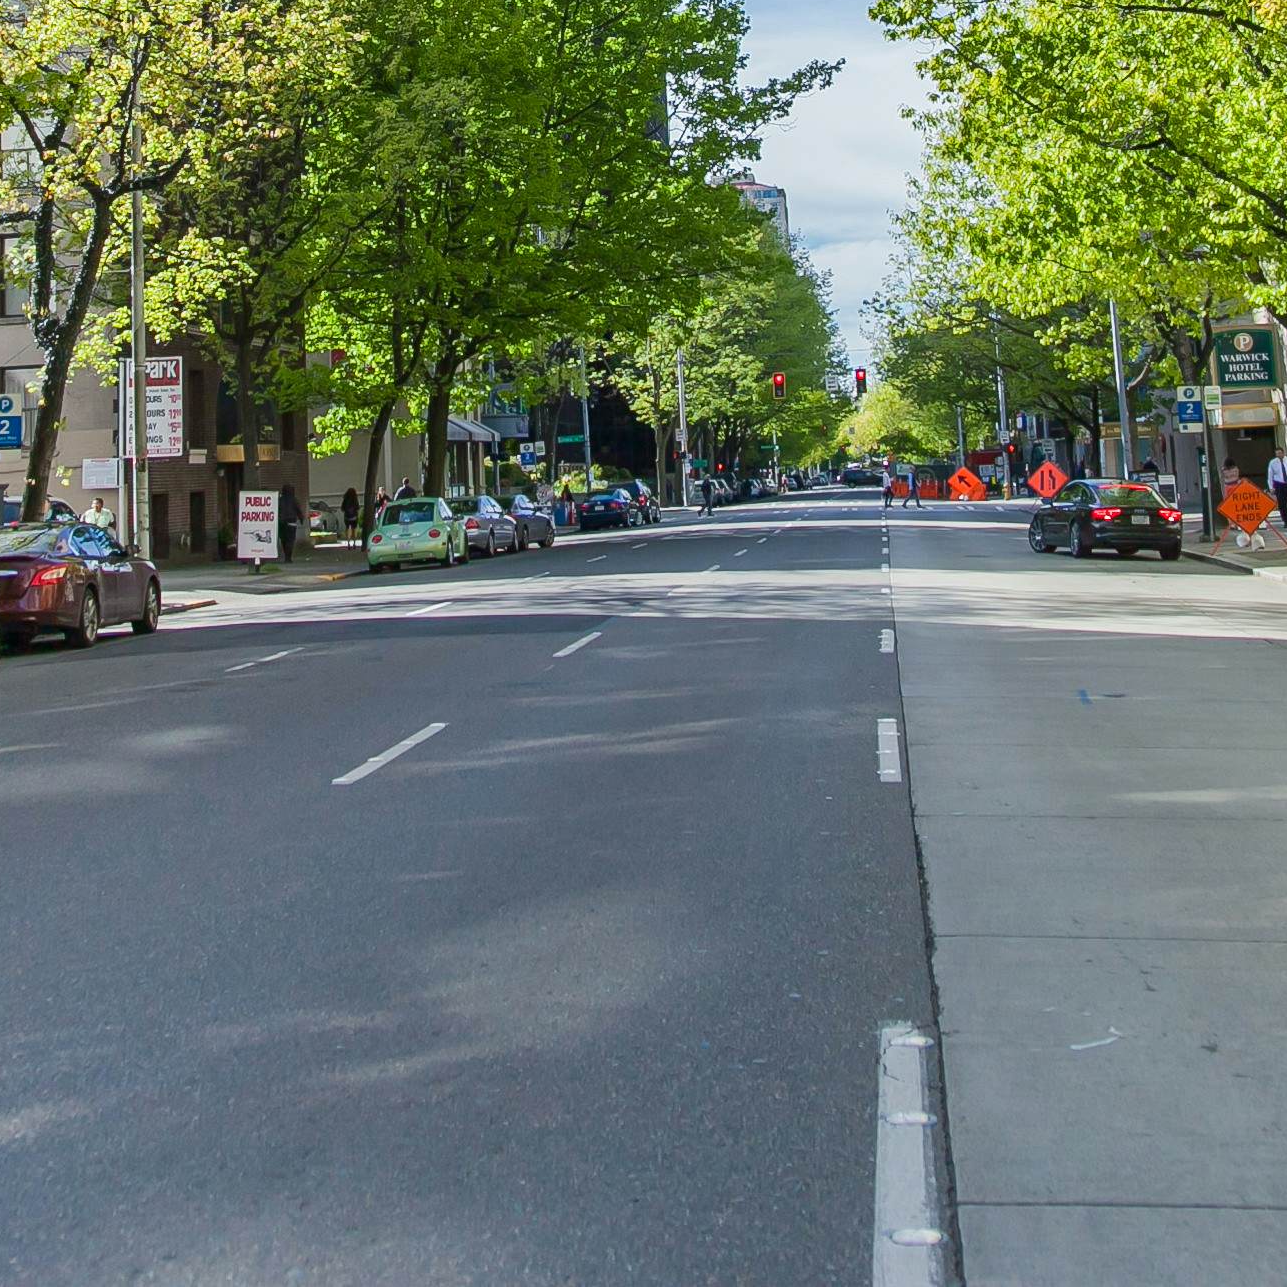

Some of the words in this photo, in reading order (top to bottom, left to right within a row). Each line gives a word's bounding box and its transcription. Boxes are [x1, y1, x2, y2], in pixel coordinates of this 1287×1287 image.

[1239, 335, 1250, 350] P
[1220, 352, 1270, 363] WARWICK
[1228, 363, 1264, 373] HOTEL
[1224, 372, 1269, 382] PARKING
[1, 399, 10, 410] P
[1186, 403, 1194, 414] 2
[0, 419, 10, 435] 2
[245, 496, 272, 507] PUBLIC
[1232, 491, 1261, 502] RIGHT
[1235, 501, 1261, 512] LANE
[241, 511, 275, 522] PARKING
[1236, 513, 1262, 523] ENDS
